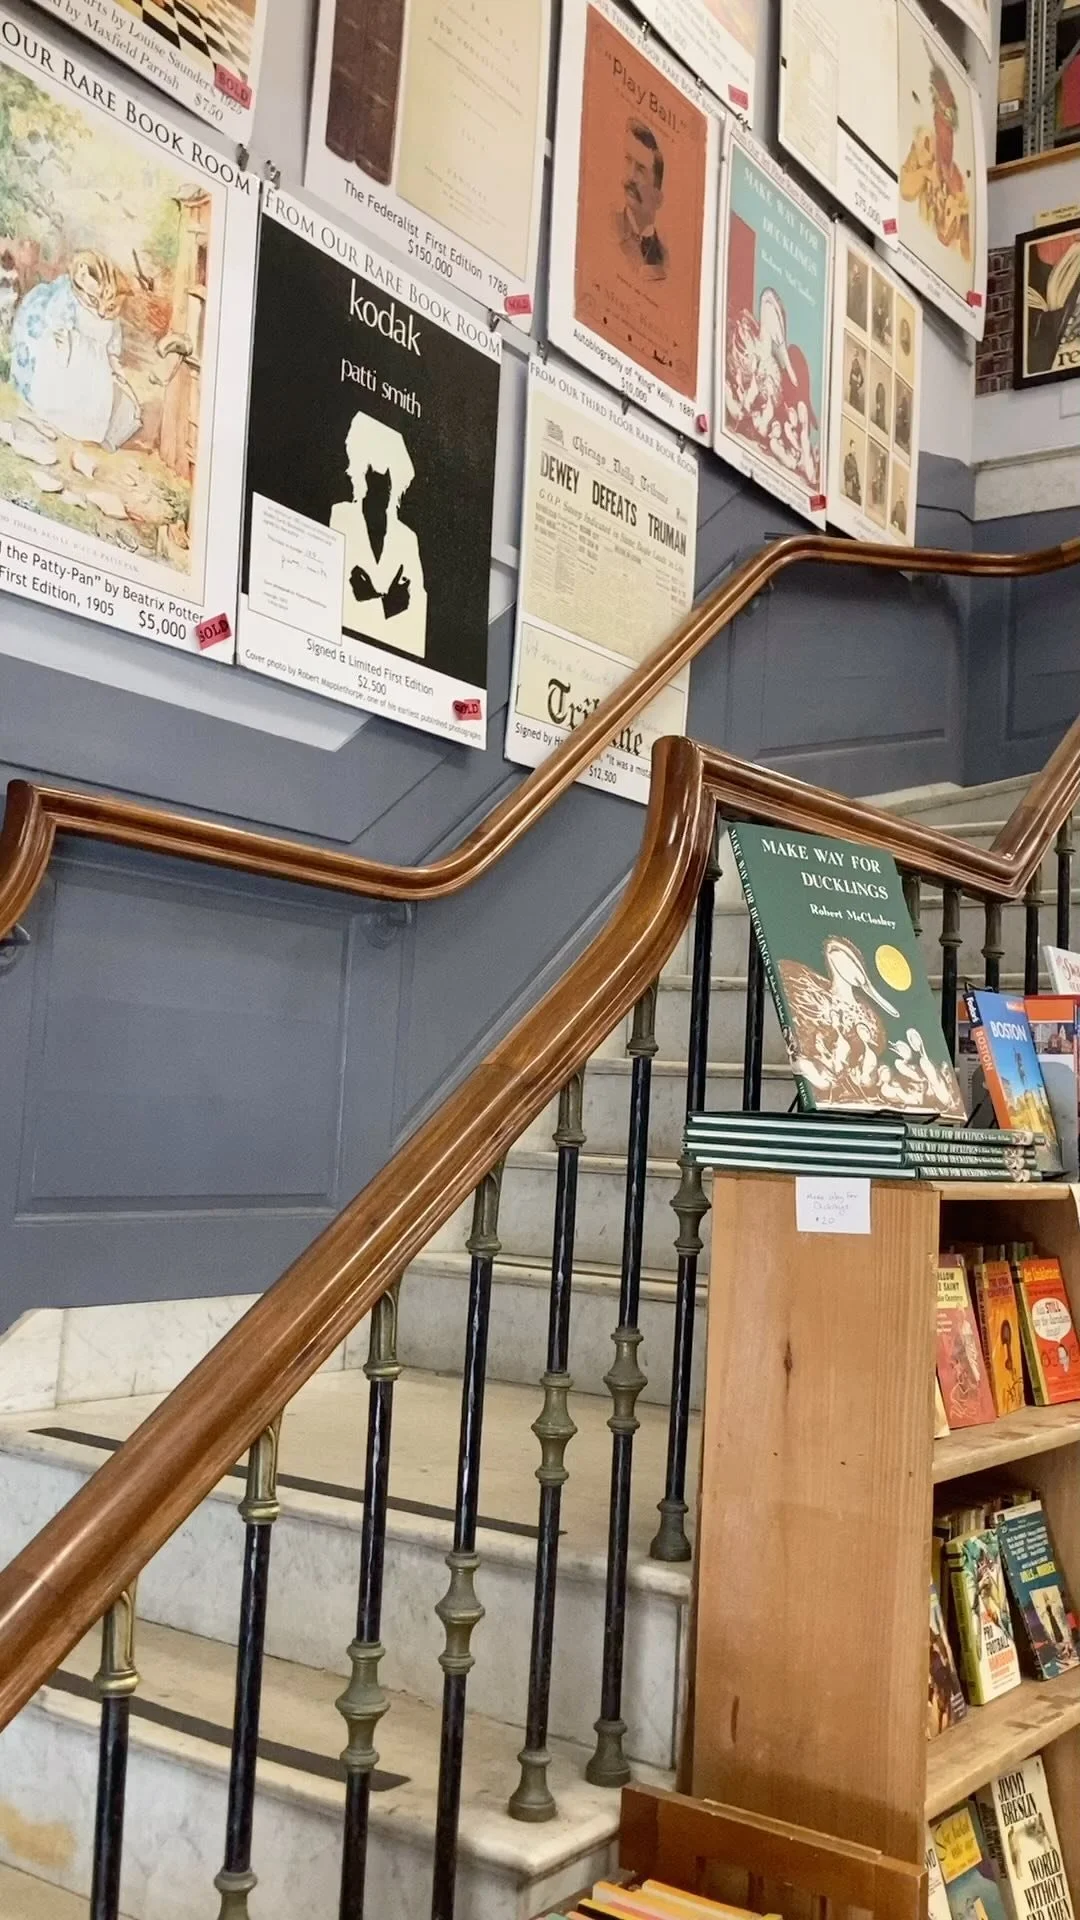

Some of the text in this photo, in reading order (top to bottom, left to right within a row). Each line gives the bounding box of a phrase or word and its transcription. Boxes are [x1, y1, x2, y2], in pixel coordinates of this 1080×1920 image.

[65, 1, 180, 92] by Maxfield Parrish
[111, 9, 126, 30] by
[128, 22, 166, 58] Louise
[218, 71, 249, 101] SOLD
[2, 21, 251, 196] OUR RARE BOOK ROOM
[193, 93, 224, 122] $750
[744, 167, 772, 207] MAKE
[344, 178, 509, 297] The Federalist First Edition 1788
[265, 188, 500, 354] FROM OUR RARE BOOK ROOM
[407, 239, 453, 279] $150,000
[350, 278, 421, 356] kodak
[573, 328, 623, 373] Autobiography
[625, 366, 633, 377] of
[341, 358, 422, 418] patti smith
[530, 362, 697, 478] FROM OUR THIRD FLOOR RARE BOOK ROOM
[572, 435, 607, 467] Chicago
[540, 450, 580, 494] DEWEY
[592, 479, 637, 527] DEFEATS
[648, 512, 687, 557] TRUMAN
[0, 565, 115, 616] First Edition, 1905
[6, 545, 28, 563] the
[104, 579, 119, 598] by
[123, 585, 165, 612] Beatrix
[169, 601, 204, 625] Potter
[138, 610, 186, 640] $5,000
[199, 619, 229, 643] SOLD
[245, 648, 265, 664] Cover
[267, 658, 287, 672] photo
[287, 664, 297, 676] by
[298, 668, 319, 684] Robert
[388, 701, 396, 711] his
[306, 638, 434, 696] Signed & Limited First Edition
[358, 675, 387, 696] $2,500
[515, 722, 541, 740] Signed
[543, 734, 552, 746] by
[589, 764, 617, 785] $12,500
[616, 758, 629, 771] was
[730, 829, 740, 860] MAKE
[761, 838, 881, 874] MAKE WAY FOR
[738, 860, 749, 882] WAY
[801, 871, 889, 900] DUCKLINGS
[743, 883, 754, 905] FOR
[810, 903, 897, 930] Robert McCloskey
[750, 906, 772, 965] DUCKLINGS
[990, 1020, 1028, 1042] BOSTON
[975, 1030, 994, 1071] BOSTON
[944, 1282, 960, 1291] SAINT
[998, 1771, 1026, 1801] JIMMY
[1001, 1792, 1038, 1828] BRESLIN
[1028, 1851, 1062, 1883] WORLD
[1024, 1874, 1067, 1912] WITHOUT
